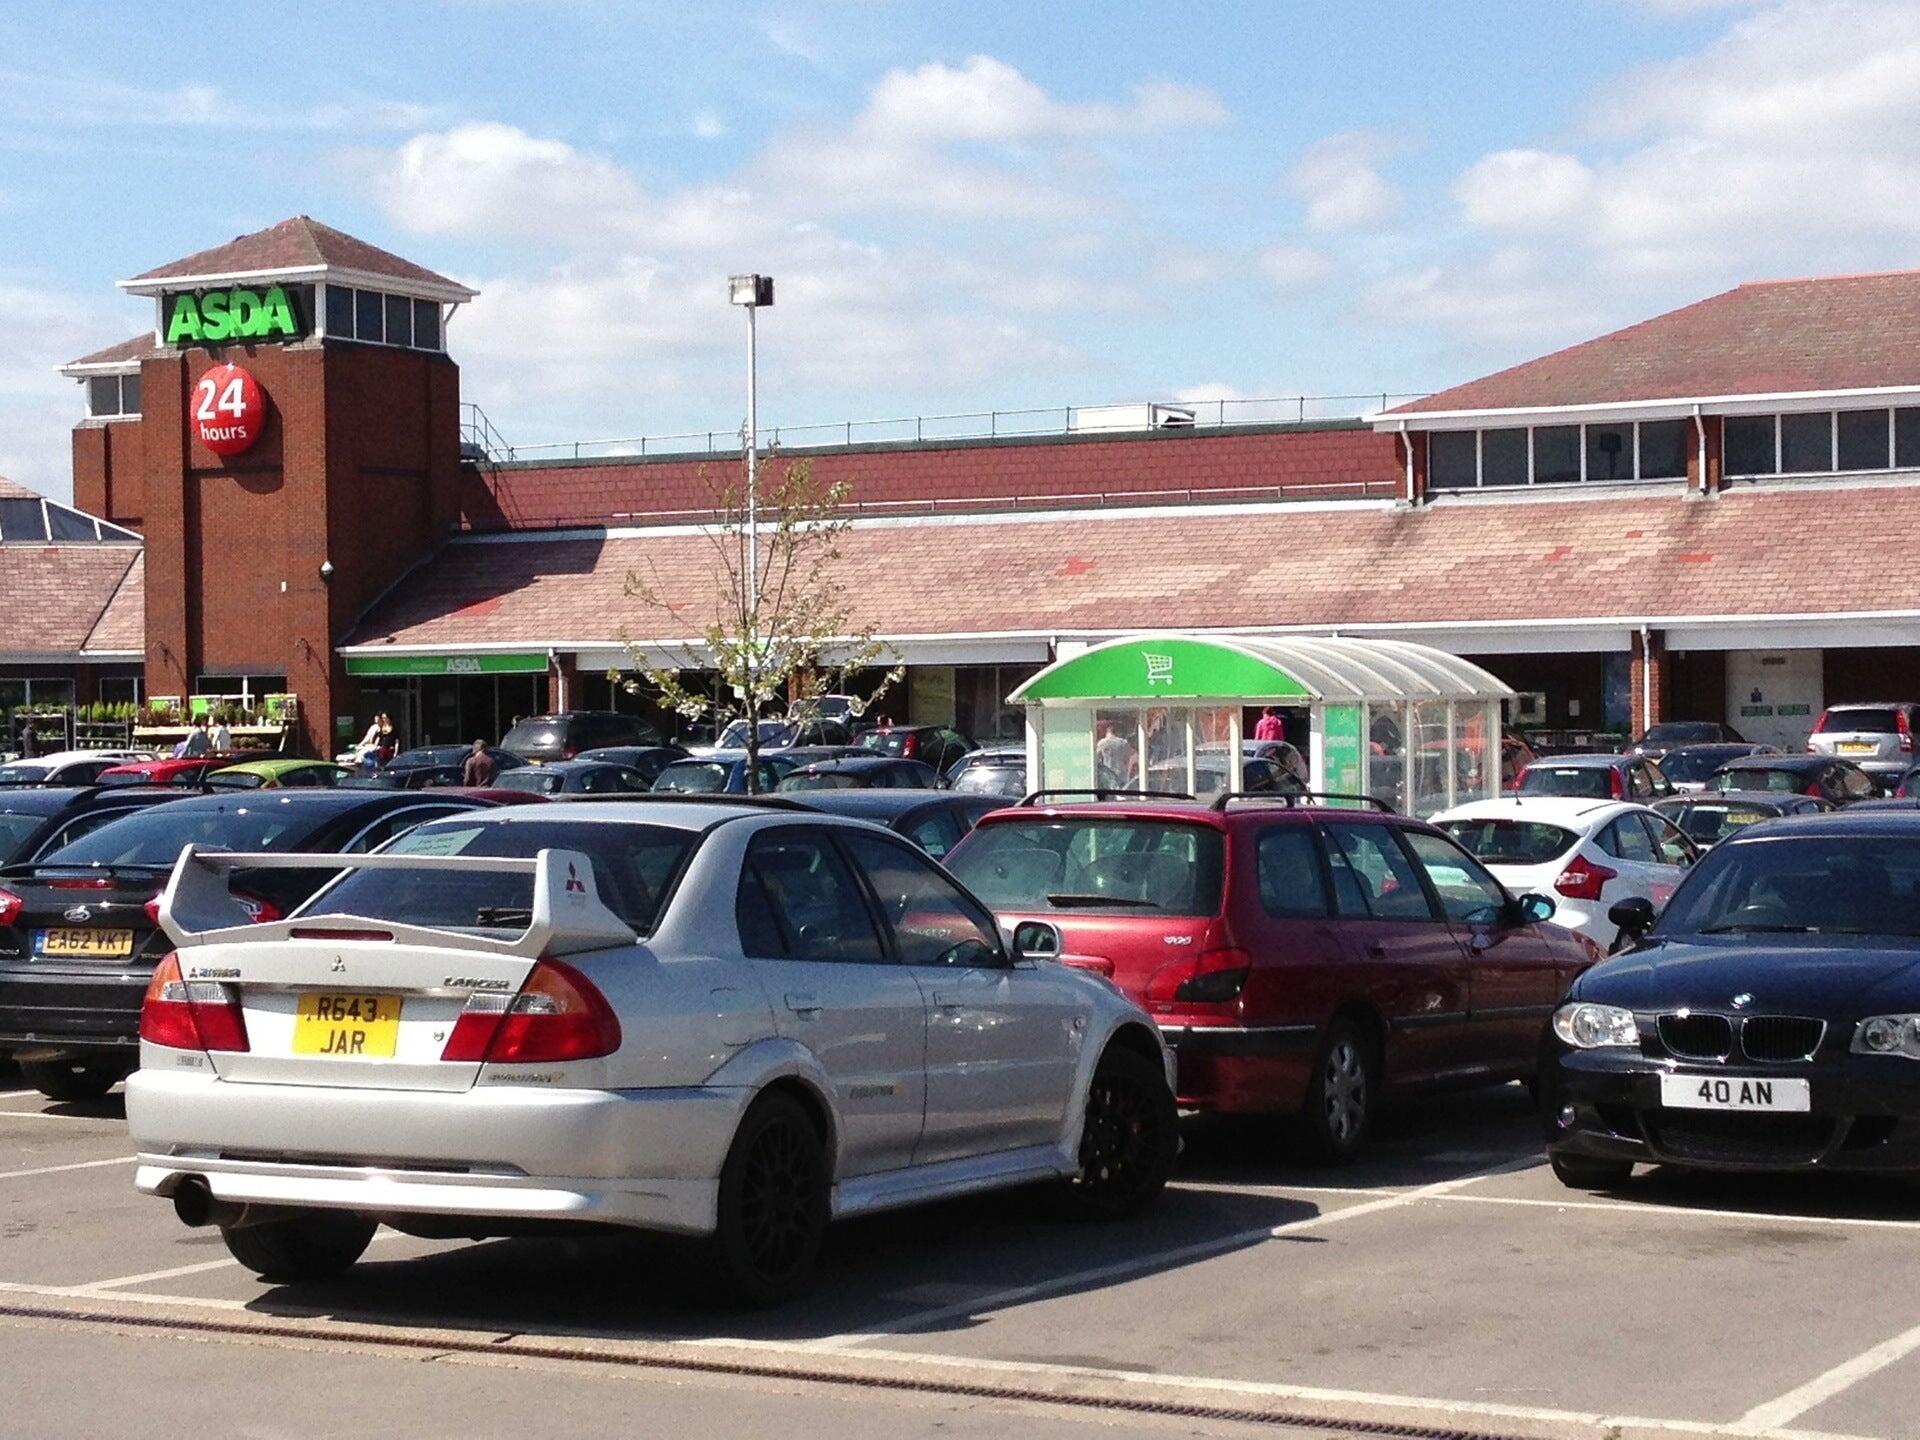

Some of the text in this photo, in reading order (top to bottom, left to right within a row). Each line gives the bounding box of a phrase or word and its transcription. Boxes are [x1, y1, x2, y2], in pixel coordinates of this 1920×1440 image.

[167, 287, 295, 342] ASDA
[197, 378, 246, 420] 24
[200, 423, 247, 440] hours
[446, 658, 482, 672] ASDA
[47, 931, 91, 950] EA62
[317, 997, 377, 1022] R643
[320, 1030, 366, 1054] JAR
[1698, 1080, 1773, 1104] 40 AN
